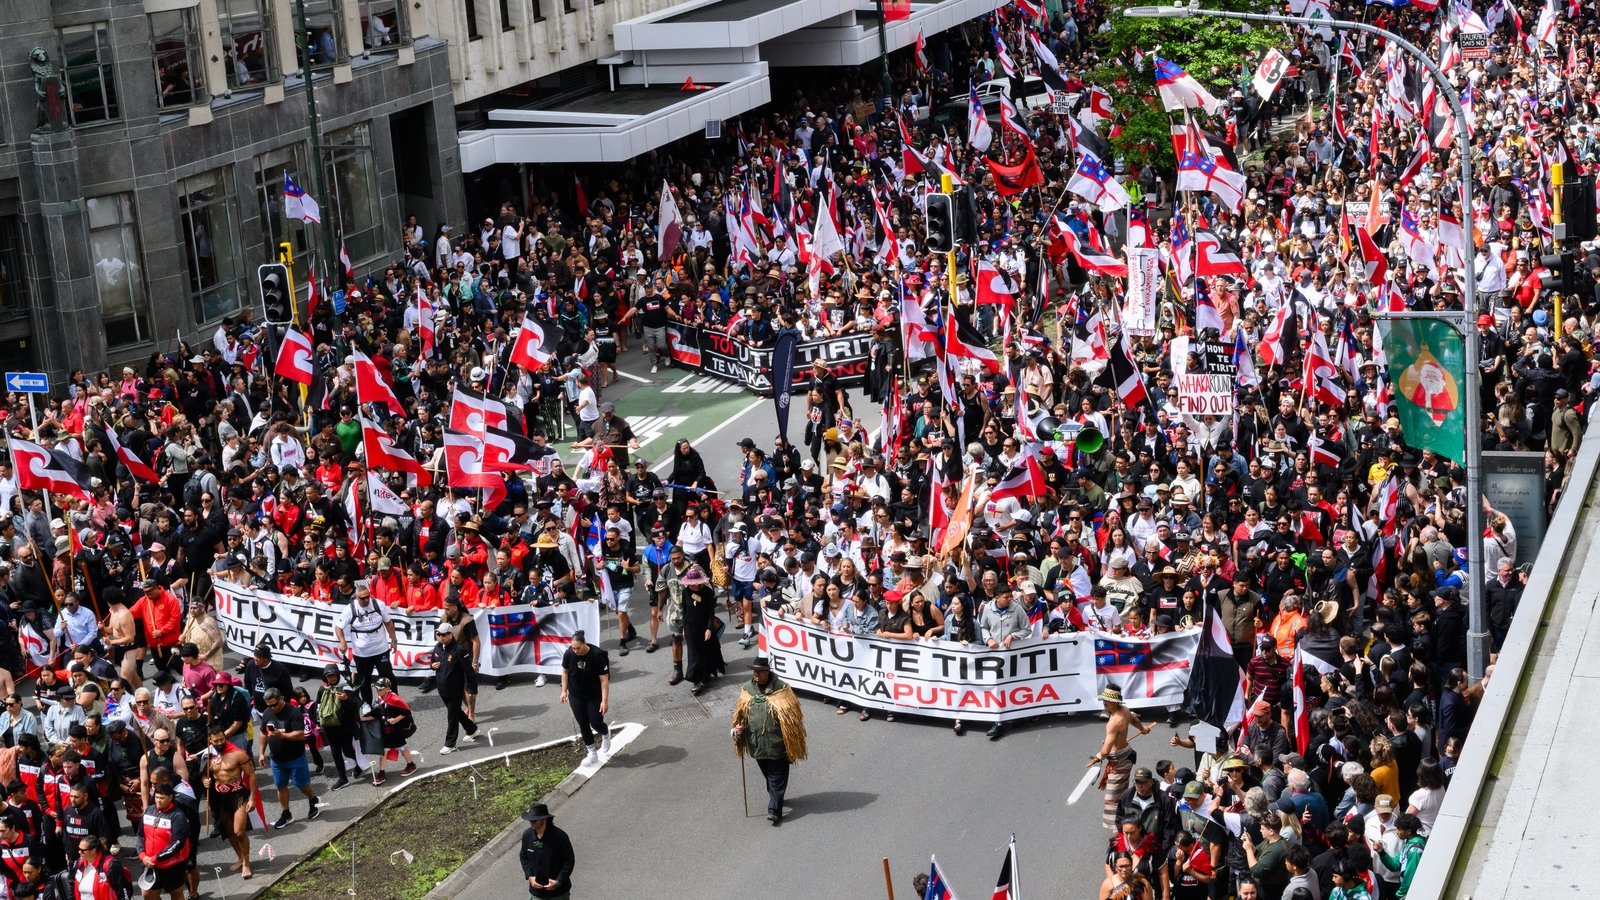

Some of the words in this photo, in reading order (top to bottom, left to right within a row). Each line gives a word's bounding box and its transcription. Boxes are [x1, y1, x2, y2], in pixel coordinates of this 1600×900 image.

[1461, 33, 1486, 41] HAURAKI
[798, 337, 874, 362] TIRIT
[712, 357, 725, 372] TE
[1217, 354, 1229, 363] TE
[1209, 363, 1236, 373] TIRIT
[1179, 395, 1207, 413] FIND
[1210, 395, 1230, 413] OUT
[214, 590, 277, 623] OITU
[291, 609, 334, 636] TE
[764, 616, 854, 662] TOITU
[869, 644, 920, 674] TE
[932, 648, 1058, 680] TIRITI
[874, 669, 895, 680] me
[795, 660, 1060, 708] WHAKAPUTANGA
